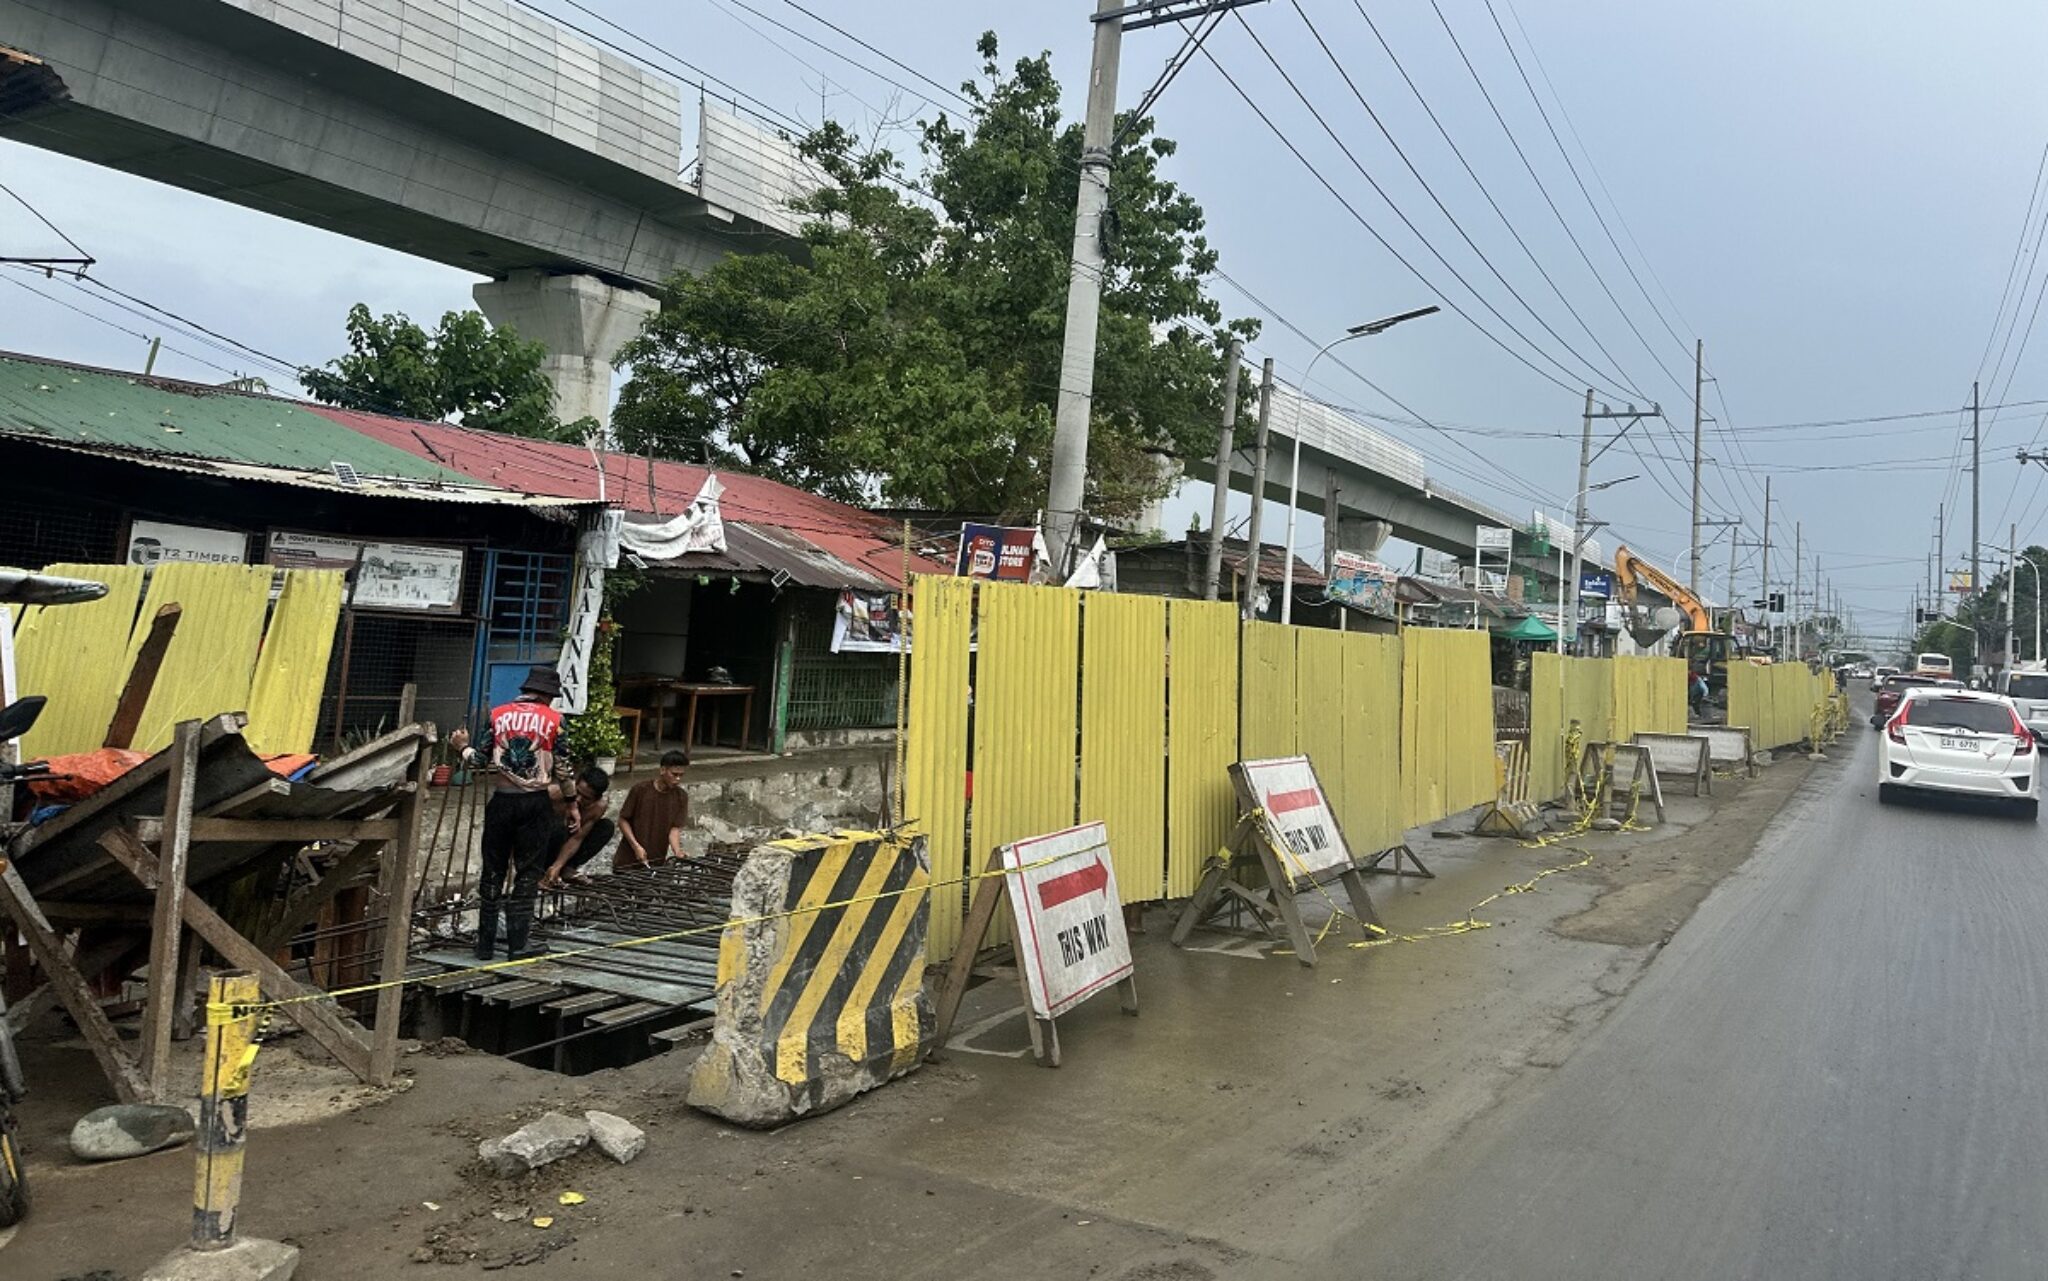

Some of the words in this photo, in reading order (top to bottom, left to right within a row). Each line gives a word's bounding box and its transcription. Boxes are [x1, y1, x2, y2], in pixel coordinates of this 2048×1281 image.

[162, 547, 180, 557] T2
[186, 550, 240, 563] TIMBER
[559, 567, 597, 709] KAINAN
[494, 711, 555, 739] BRUTALE
[1284, 828, 1310, 856] THIS
[1305, 823, 1329, 851] WAY
[1056, 925, 1085, 968] THIS
[1082, 914, 1110, 956] WAY
